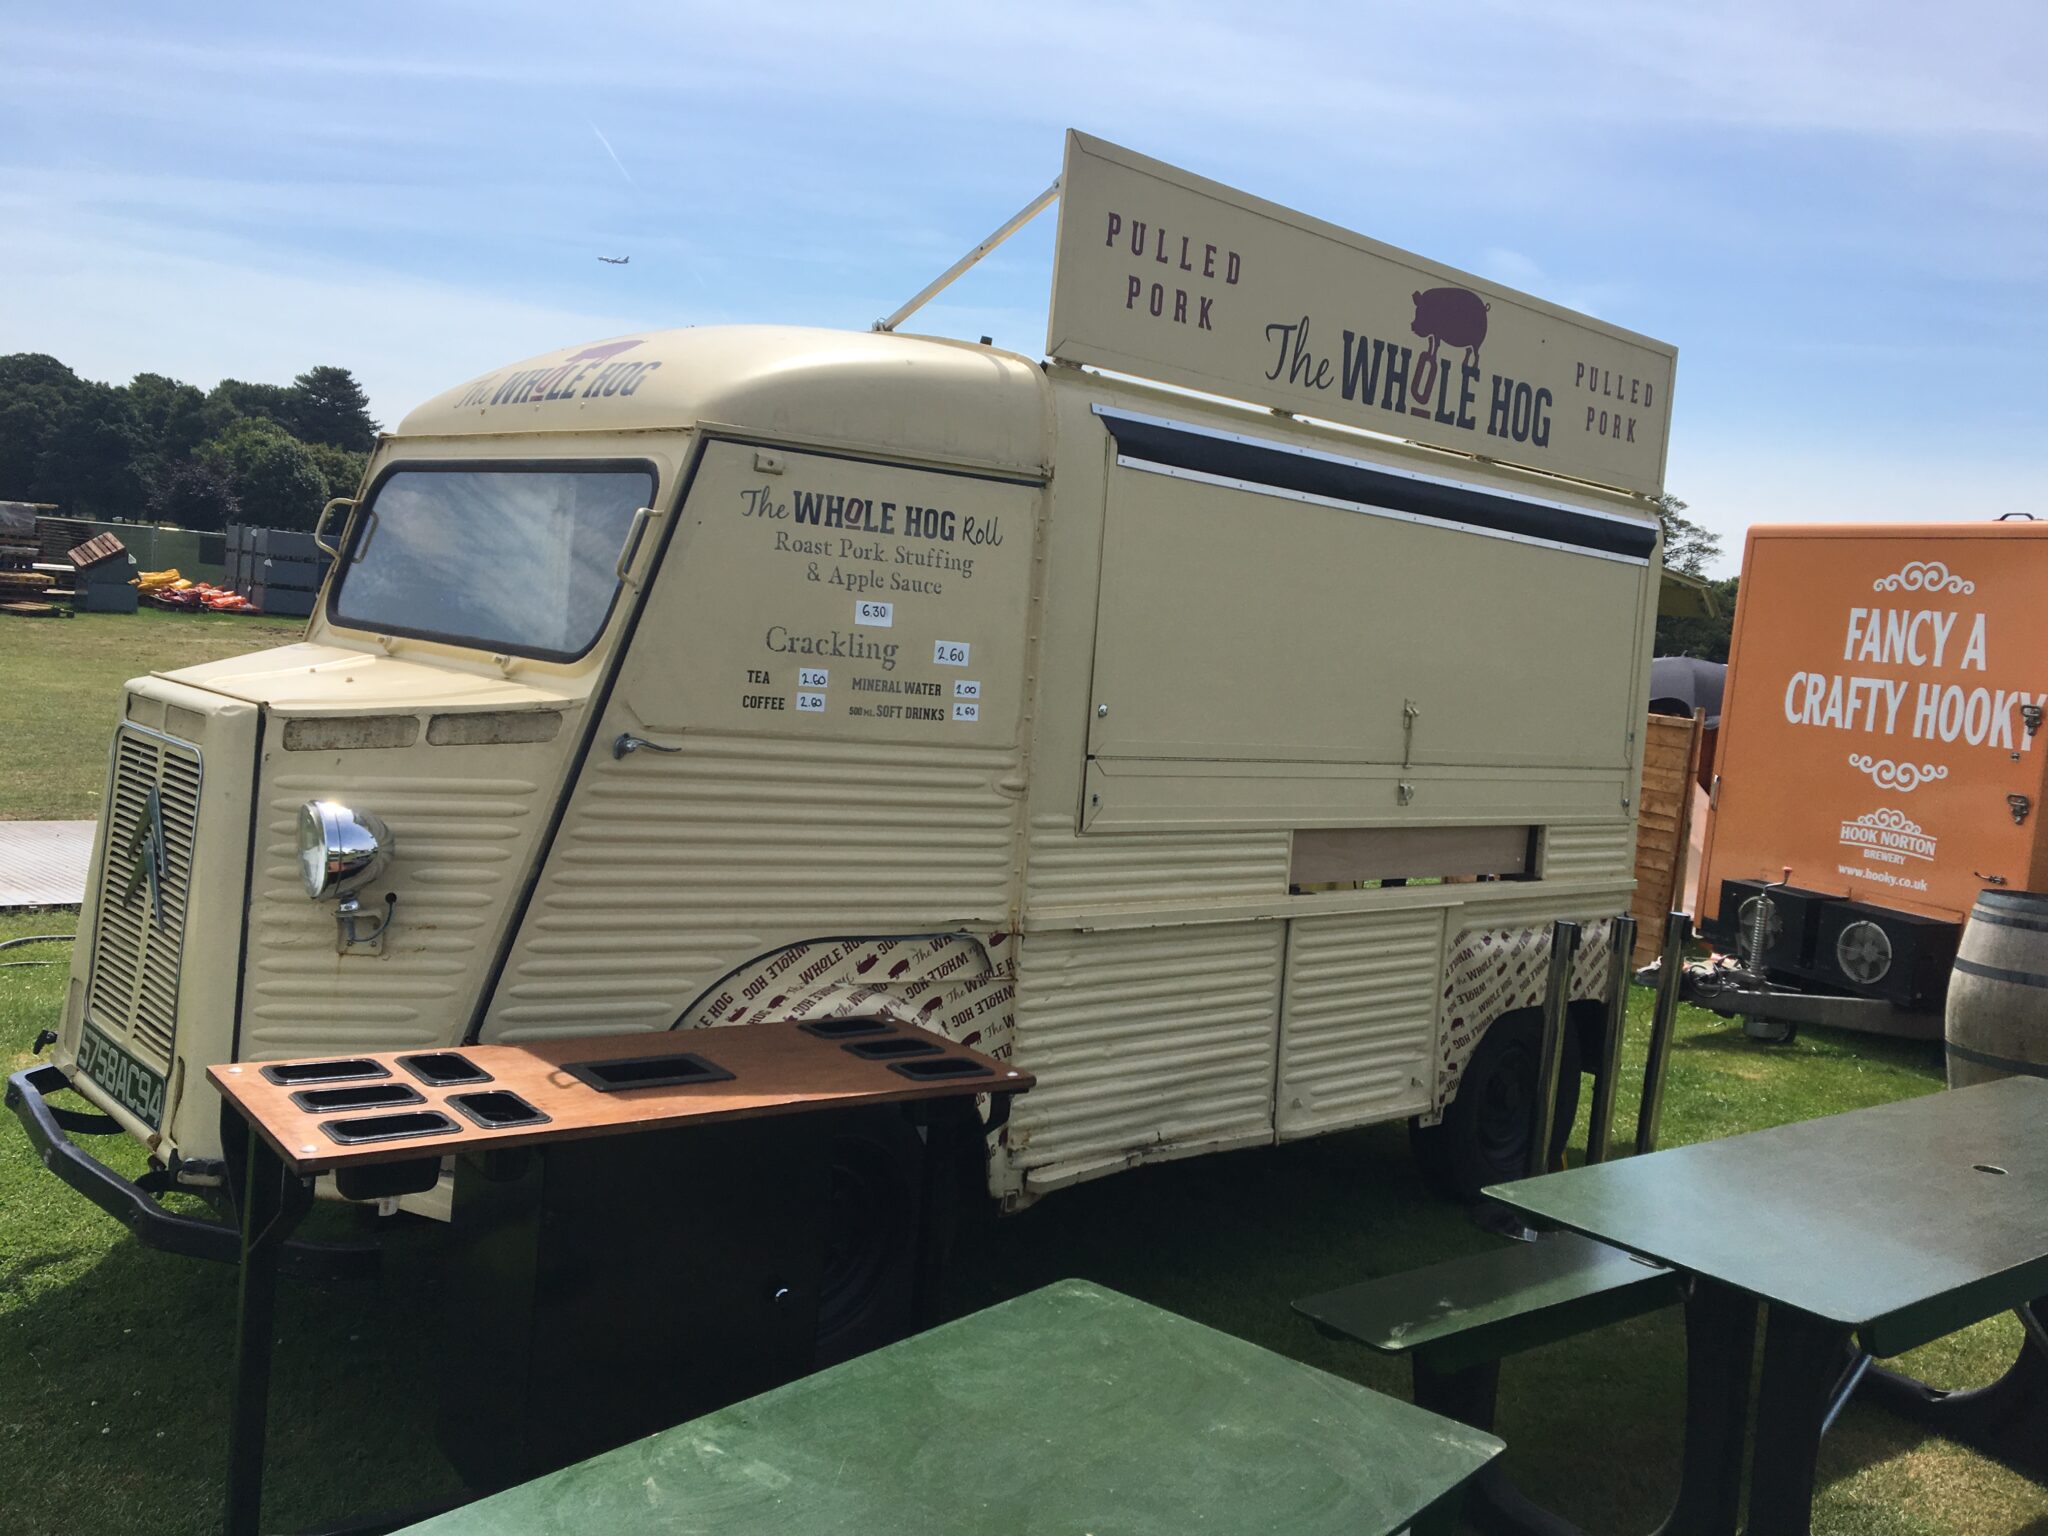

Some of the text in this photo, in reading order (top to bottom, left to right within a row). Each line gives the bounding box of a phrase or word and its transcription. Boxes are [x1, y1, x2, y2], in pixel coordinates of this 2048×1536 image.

[1105, 211, 1242, 286] PULLED
[1125, 274, 1215, 332] PORK
[454, 360, 662, 408] The WHOLE HOG
[1265, 315, 1553, 448] The WHOLE HOG
[1575, 361, 1654, 408] PULLED
[1586, 406, 1637, 443] PORK
[740, 485, 1003, 546] The WHOLE HOG Roll
[774, 531, 832, 557] Roast
[894, 545, 974, 579] Stuffing
[806, 561, 942, 595] & Apple Sauce
[862, 604, 887, 618] 6.30
[766, 625, 899, 671] Crackling
[937, 645, 965, 662] 2.60
[1844, 607, 1987, 671] FANCY A
[746, 669, 770, 685] TEA
[851, 677, 942, 696] MINERAL WATER
[742, 694, 786, 710] COFFEE
[875, 703, 903, 719] SOFT
[905, 705, 945, 721] DRINKS
[1784, 671, 2048, 752] CRAFTY HOOKY
[1840, 825, 1937, 856] HOOK NORTON
[1863, 848, 1906, 865] BREWERY
[1838, 864, 1928, 892] www.hooky.co.uk
[765, 943, 810, 981] WHOLE
[799, 947, 844, 985] WHOLE
[926, 951, 969, 980] WHOLE
[742, 974, 769, 1001] HOG
[946, 987, 966, 1003] The
[975, 985, 1016, 1015] WHOLE
[708, 991, 735, 1019] HOG
[951, 1006, 975, 1028] HOG
[1453, 1033, 1471, 1049] HOG
[78, 1024, 162, 1128] 5758AC94
